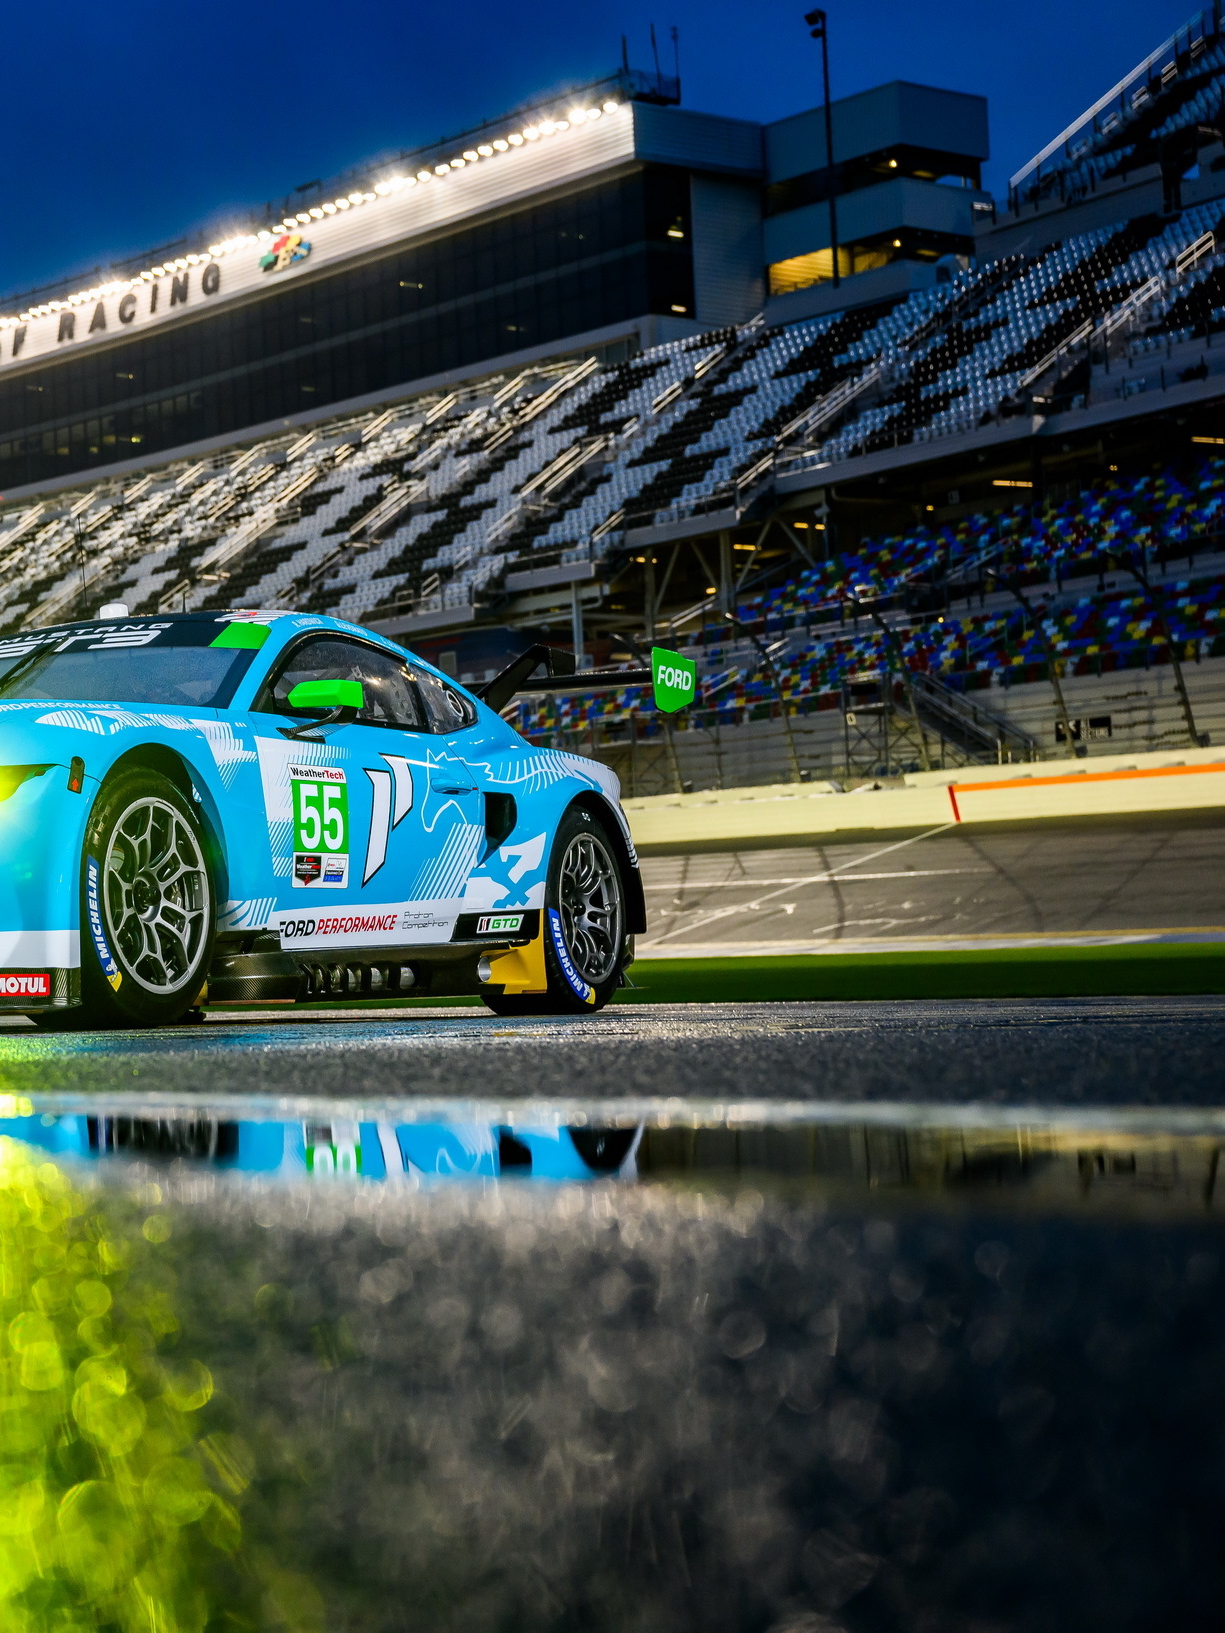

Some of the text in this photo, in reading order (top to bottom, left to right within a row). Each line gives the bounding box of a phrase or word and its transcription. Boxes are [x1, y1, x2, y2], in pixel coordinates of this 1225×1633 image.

[57, 263, 220, 342] RACING
[657, 665, 692, 690] FORD
[290, 766, 345, 780] WeatherTech
[299, 783, 344, 851] 55
[88, 864, 110, 959] MICHELIN
[404, 911, 434, 920] Proton
[491, 917, 520, 929] GTD
[552, 917, 584, 992] MICHELIN
